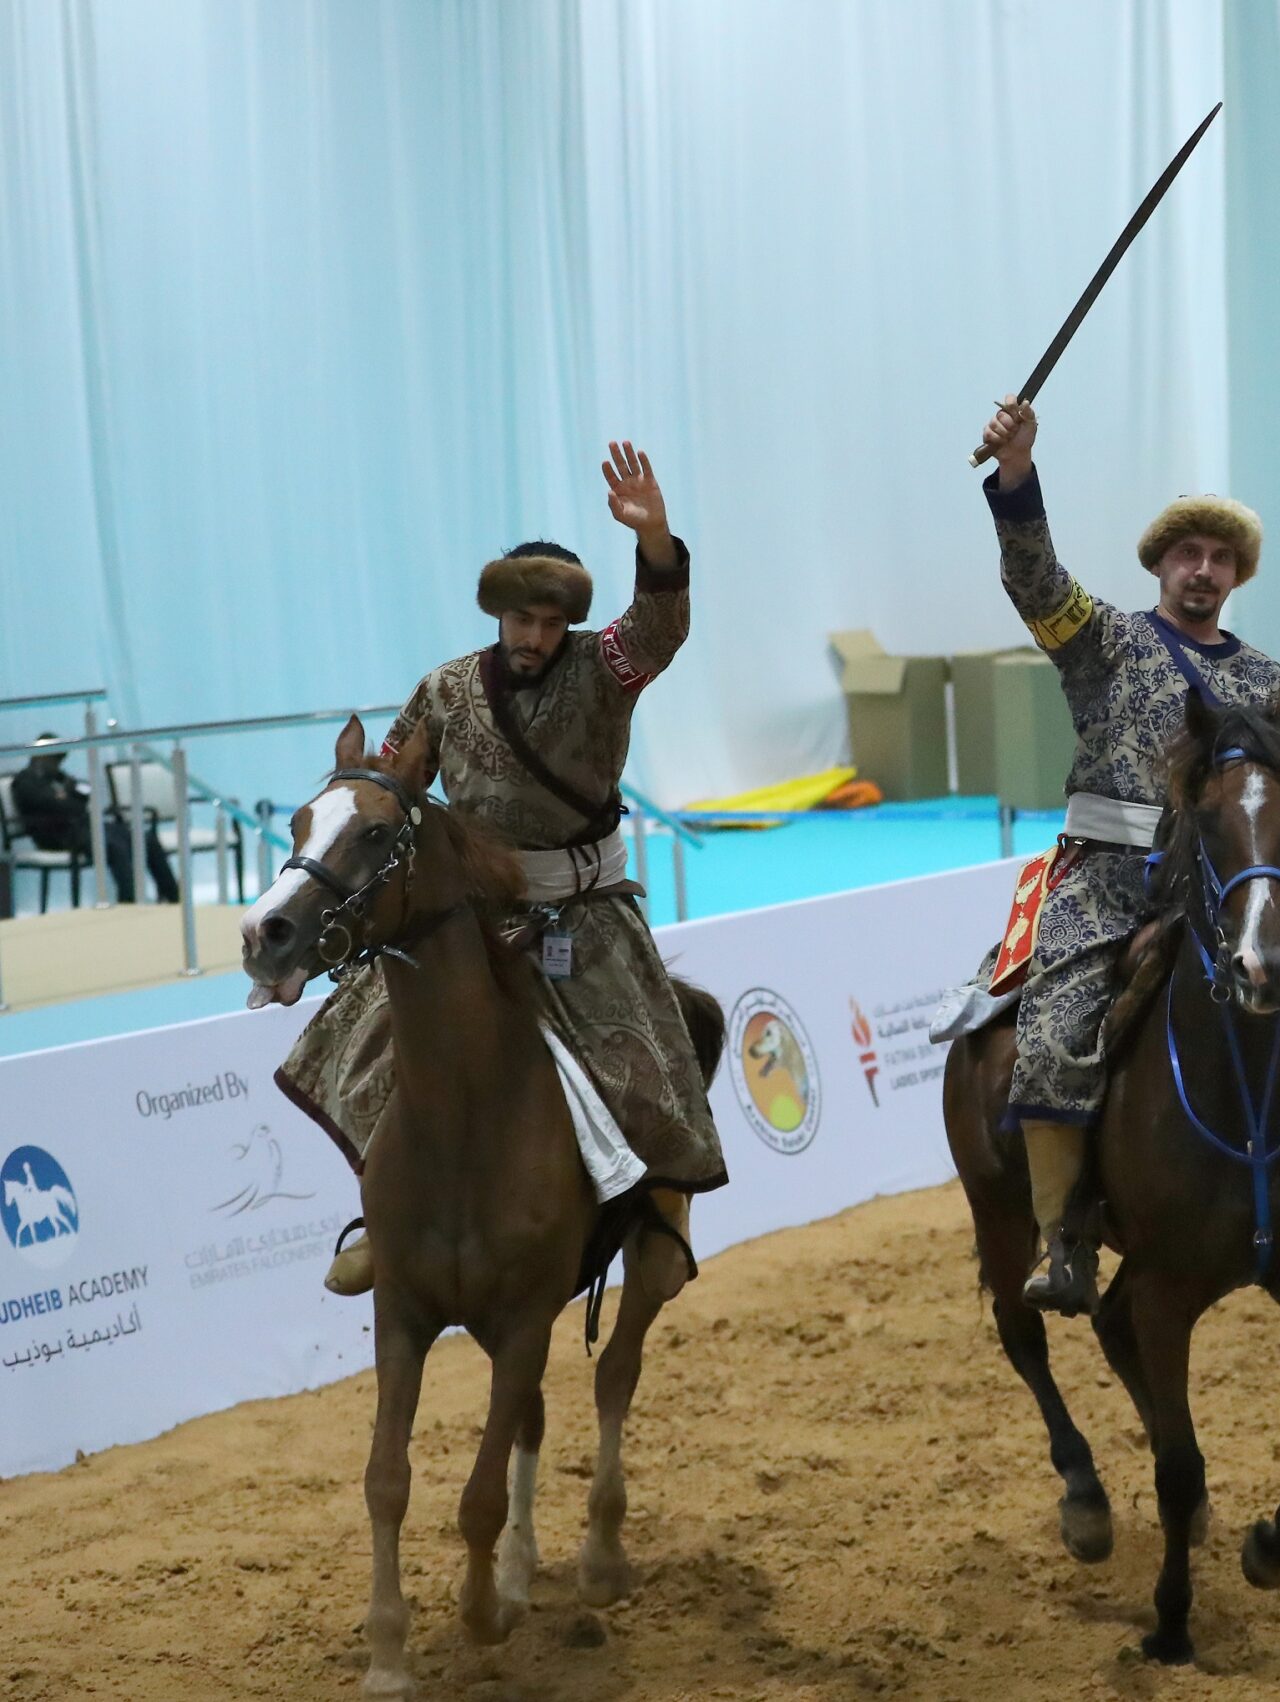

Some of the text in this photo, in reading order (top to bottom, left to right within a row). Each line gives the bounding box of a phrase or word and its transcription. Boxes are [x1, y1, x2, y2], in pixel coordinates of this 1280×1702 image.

[136, 1071, 250, 1120] Organized By
[68, 1266, 149, 1307] ACADEMY
[190, 1262, 251, 1290] EMIRATES
[2, 1302, 143, 1371] أكاديمية بوذيب
